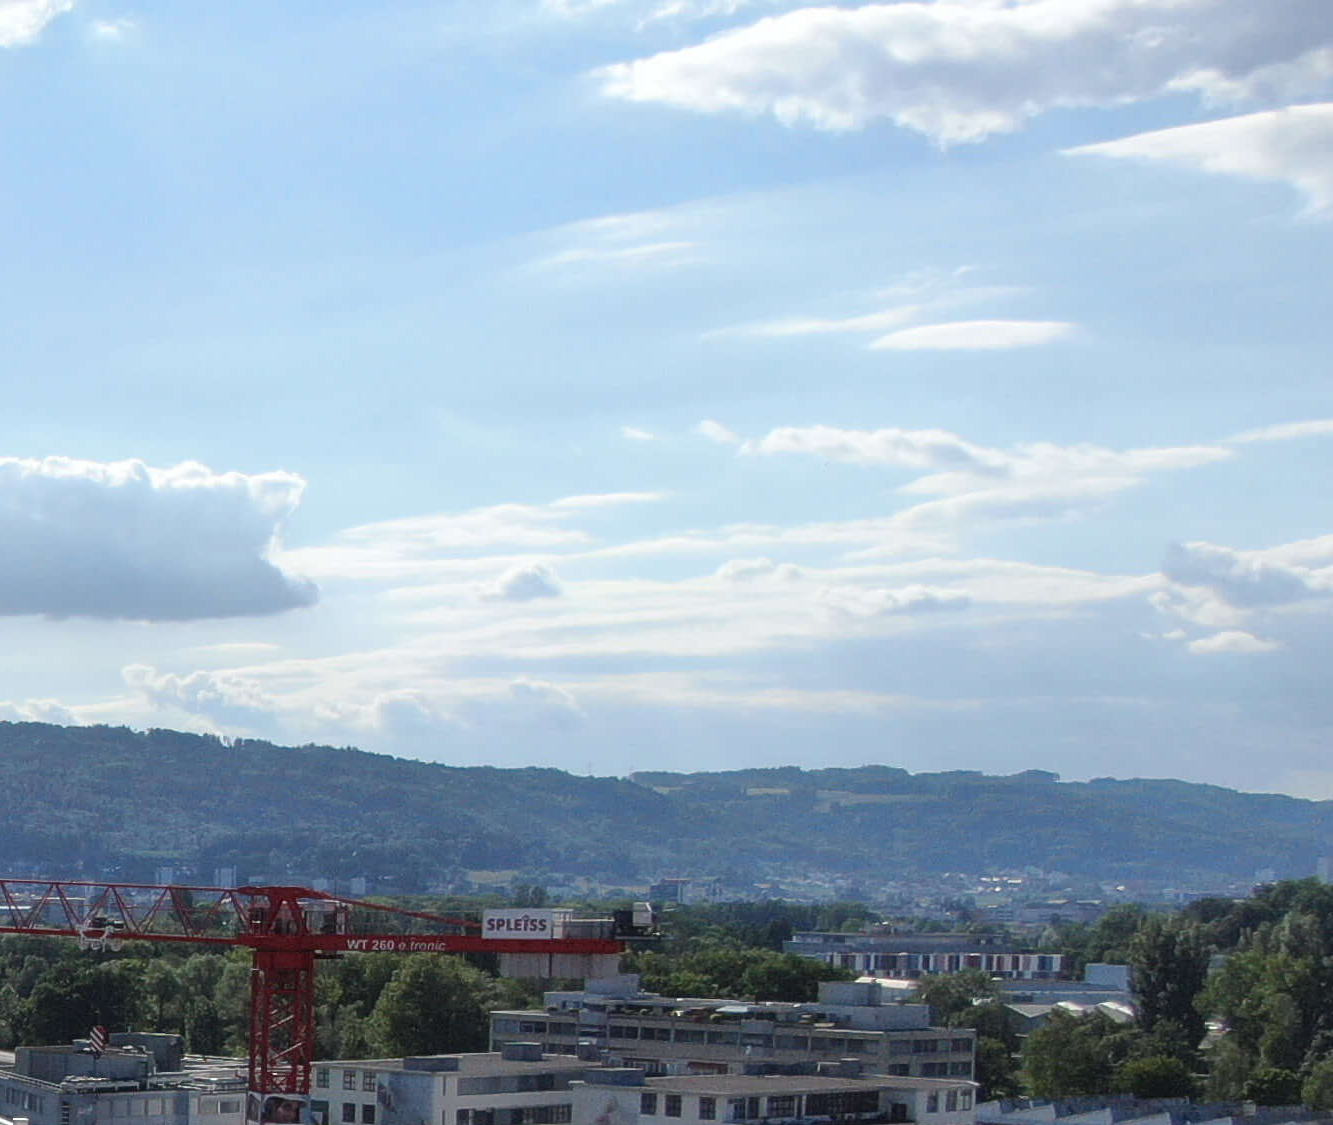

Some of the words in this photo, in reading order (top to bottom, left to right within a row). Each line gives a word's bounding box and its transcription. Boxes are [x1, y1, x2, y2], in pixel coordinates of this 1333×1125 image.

[487, 916, 547, 932] SPLEISS
[347, 939, 368, 950] WT
[373, 940, 394, 950] 260
